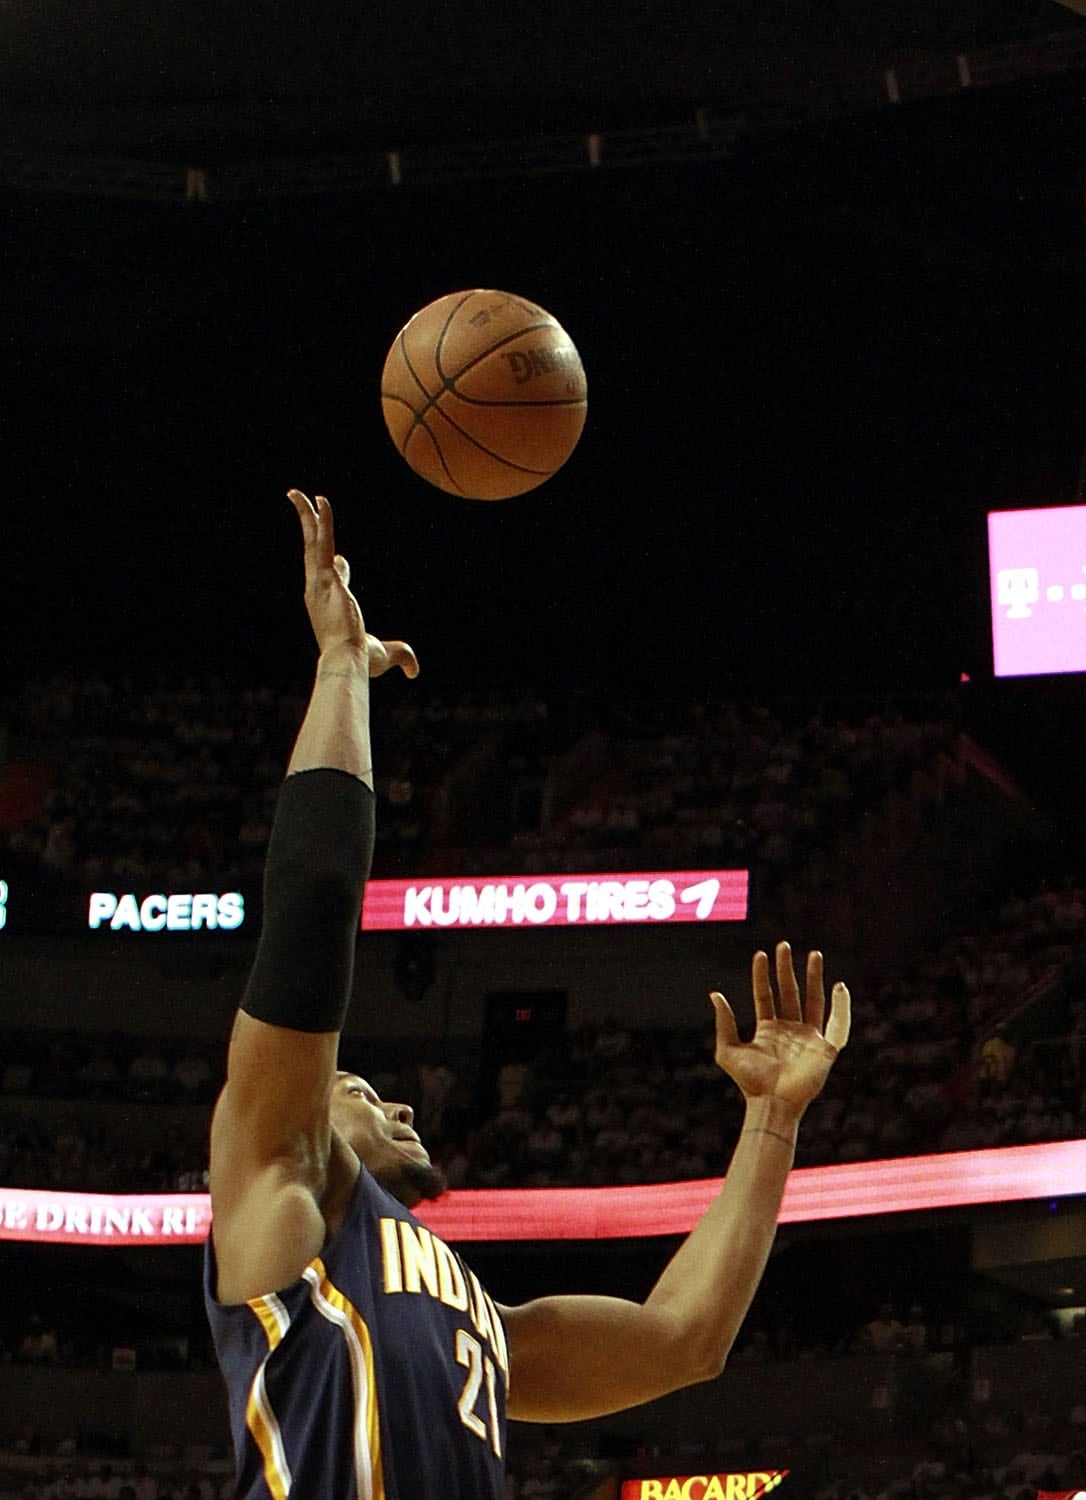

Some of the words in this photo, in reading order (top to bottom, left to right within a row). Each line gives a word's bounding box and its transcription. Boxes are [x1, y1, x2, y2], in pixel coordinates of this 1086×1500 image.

[88, 892, 245, 932] PACERS
[403, 883, 557, 926] KUMHO
[560, 878, 677, 922] TIRES
[36, 1203, 154, 1236] DRINK
[455, 1328, 502, 1459] 21
